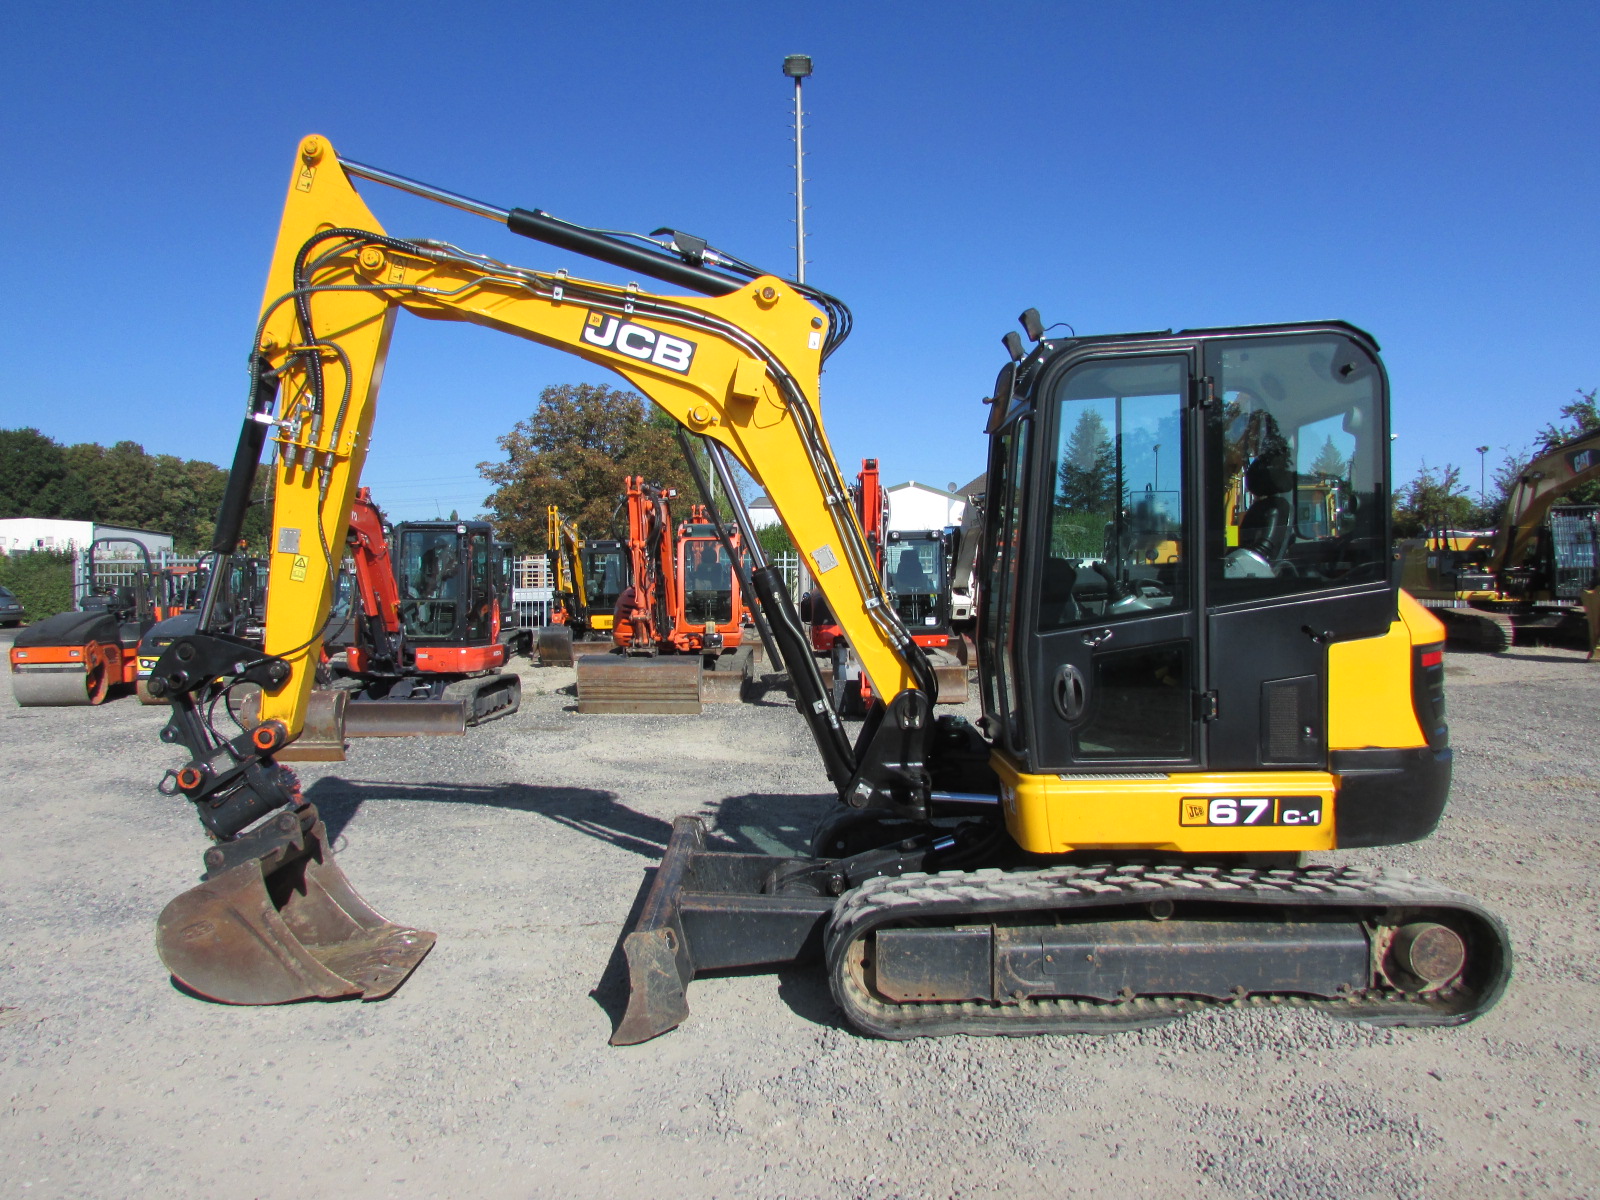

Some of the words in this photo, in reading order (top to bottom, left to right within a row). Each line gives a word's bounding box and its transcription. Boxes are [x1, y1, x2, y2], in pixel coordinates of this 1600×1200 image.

[584, 318, 692, 371] JCB
[1574, 450, 1590, 472] CAT
[1188, 805, 1204, 818] JCB
[1208, 798, 1269, 824] 67
[1282, 809, 1320, 824] C-1
